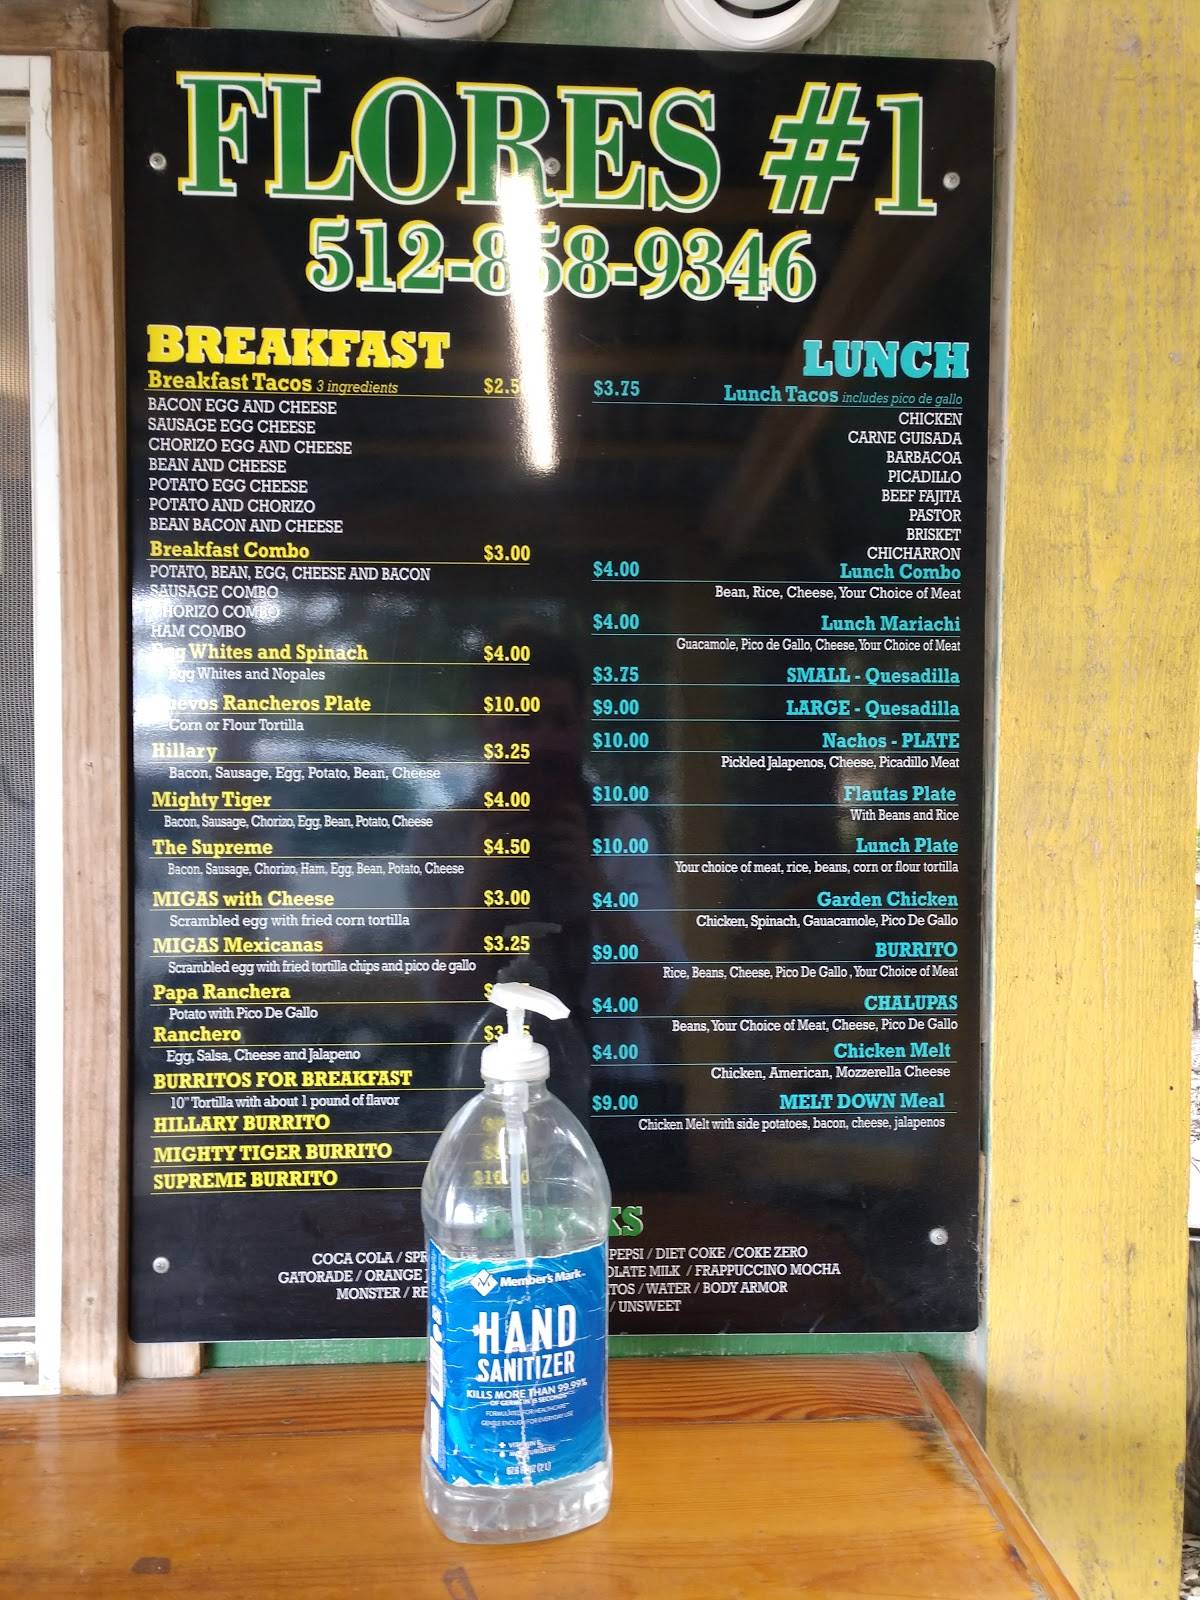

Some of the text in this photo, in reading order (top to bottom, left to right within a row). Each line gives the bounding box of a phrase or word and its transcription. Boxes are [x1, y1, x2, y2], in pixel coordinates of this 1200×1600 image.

[176, 70, 938, 217] FLORES #1
[147, 324, 450, 369] BREAKFAST
[803, 340, 969, 378] LUNCH
[148, 370, 398, 396] Breakfast Tacos 3 ingredients
[484, 377, 524, 395] $2.5
[593, 380, 640, 397] $3.75
[723, 384, 963, 408] Lunch Tacos includes pico de gallo
[148, 398, 337, 415] BACON EGG AND CHEESE
[147, 418, 316, 434] SAUSAGE EGG CHEESE
[899, 412, 962, 426] CHICKEN
[848, 431, 962, 445] CARNE GUISADA
[148, 458, 286, 473] BEAN AND CHEESE
[886, 451, 962, 465] BARBACOA
[888, 470, 962, 484] PICADILLO
[881, 489, 962, 505] BEEF FAJITA
[909, 509, 961, 522] PASTOR
[906, 528, 961, 541] BRISKET
[150, 540, 310, 559] Breakfast Combo
[484, 544, 531, 562] $3.00
[867, 546, 961, 561] CHICHARRON
[150, 565, 431, 582] POTATO, BEAN, EGG, CHEESE AND BACON
[593, 561, 640, 578] $4.00
[840, 563, 961, 580] Lunch Combo
[593, 614, 640, 631] $4.00
[821, 615, 960, 632] Lunch Mariachi
[190, 644, 253, 659] Whites
[257, 645, 291, 660] and
[296, 644, 368, 664] Spinach
[483, 645, 530, 663] $4.00
[593, 666, 639, 683] $3.75
[787, 667, 960, 685] SMALL Quesadilla
[223, 695, 371, 711] Rancheros Plate
[483, 696, 540, 714] $10.00
[593, 699, 640, 716] $9.00
[786, 700, 960, 718] LARGE Quesadilla
[593, 732, 649, 749] $10.00
[822, 732, 960, 748] Nachos PLATE
[152, 743, 217, 762] Hillary
[483, 743, 530, 760] $3.25
[721, 755, 959, 771] Pickled Jalapenos, Cheese, Picadillo Meat
[152, 791, 272, 812] Mighty Tiger
[483, 791, 530, 809] $4.00
[592, 785, 649, 802] $10.00
[844, 786, 956, 801] Flautas Plate
[152, 839, 273, 859] The Supreme
[483, 838, 530, 856] $4.50
[592, 838, 648, 854] $10.00
[855, 837, 959, 853] Lunch Plate
[152, 890, 335, 907] MIGAS with Cheese
[483, 890, 530, 907] $3.00
[592, 892, 639, 908] $4.00
[817, 891, 959, 907] Garden Chicken
[170, 914, 410, 930] Scrambled egg with fried corn tortilla
[153, 937, 323, 954] MIGAS Mexicanas
[483, 935, 530, 953] $3.25
[592, 944, 639, 961] $9.00
[875, 942, 959, 958] BURRITO
[153, 984, 291, 1003] Papa Ranchera
[592, 997, 639, 1014] $4.00
[864, 995, 958, 1011] CHALUPAS
[153, 1027, 241, 1042] Ranchero
[592, 1044, 639, 1061] $4.00
[834, 1042, 951, 1059] Chicken Melt
[153, 1070, 412, 1089] BURRITOS FOR BREAKFAST
[592, 1095, 639, 1111] $9.00
[779, 1093, 944, 1110] MELT DOWN Meal
[153, 1114, 330, 1133] HILLARY BURRITO
[153, 1143, 392, 1163] MIGHTY TIGER BURRITO
[153, 1171, 338, 1190] SUPREME BURRITO
[312, 1252, 394, 1266] COCA COLA
[609, 1247, 645, 1261] PEPSI
[657, 1247, 686, 1260] DIET
[689, 1247, 725, 1260] COKE
[774, 1245, 808, 1259] ZERO
[277, 1269, 422, 1284] GATORADE ORANGE
[646, 1262, 841, 1278] MILK FRAPPUCCINO MOCHA
[500, 1274, 554, 1287] Member's
[645, 1280, 788, 1295] WATER BODY ARMOR
[336, 1287, 402, 1301] MONSTER
[618, 1299, 681, 1313] UNSWEET
[478, 1304, 577, 1354] HAND
[477, 1350, 575, 1382] SANITIZER
[466, 1389, 493, 1399] KILLS
[494, 1389, 525, 1400] MORE
[529, 1387, 555, 1398] THAN
